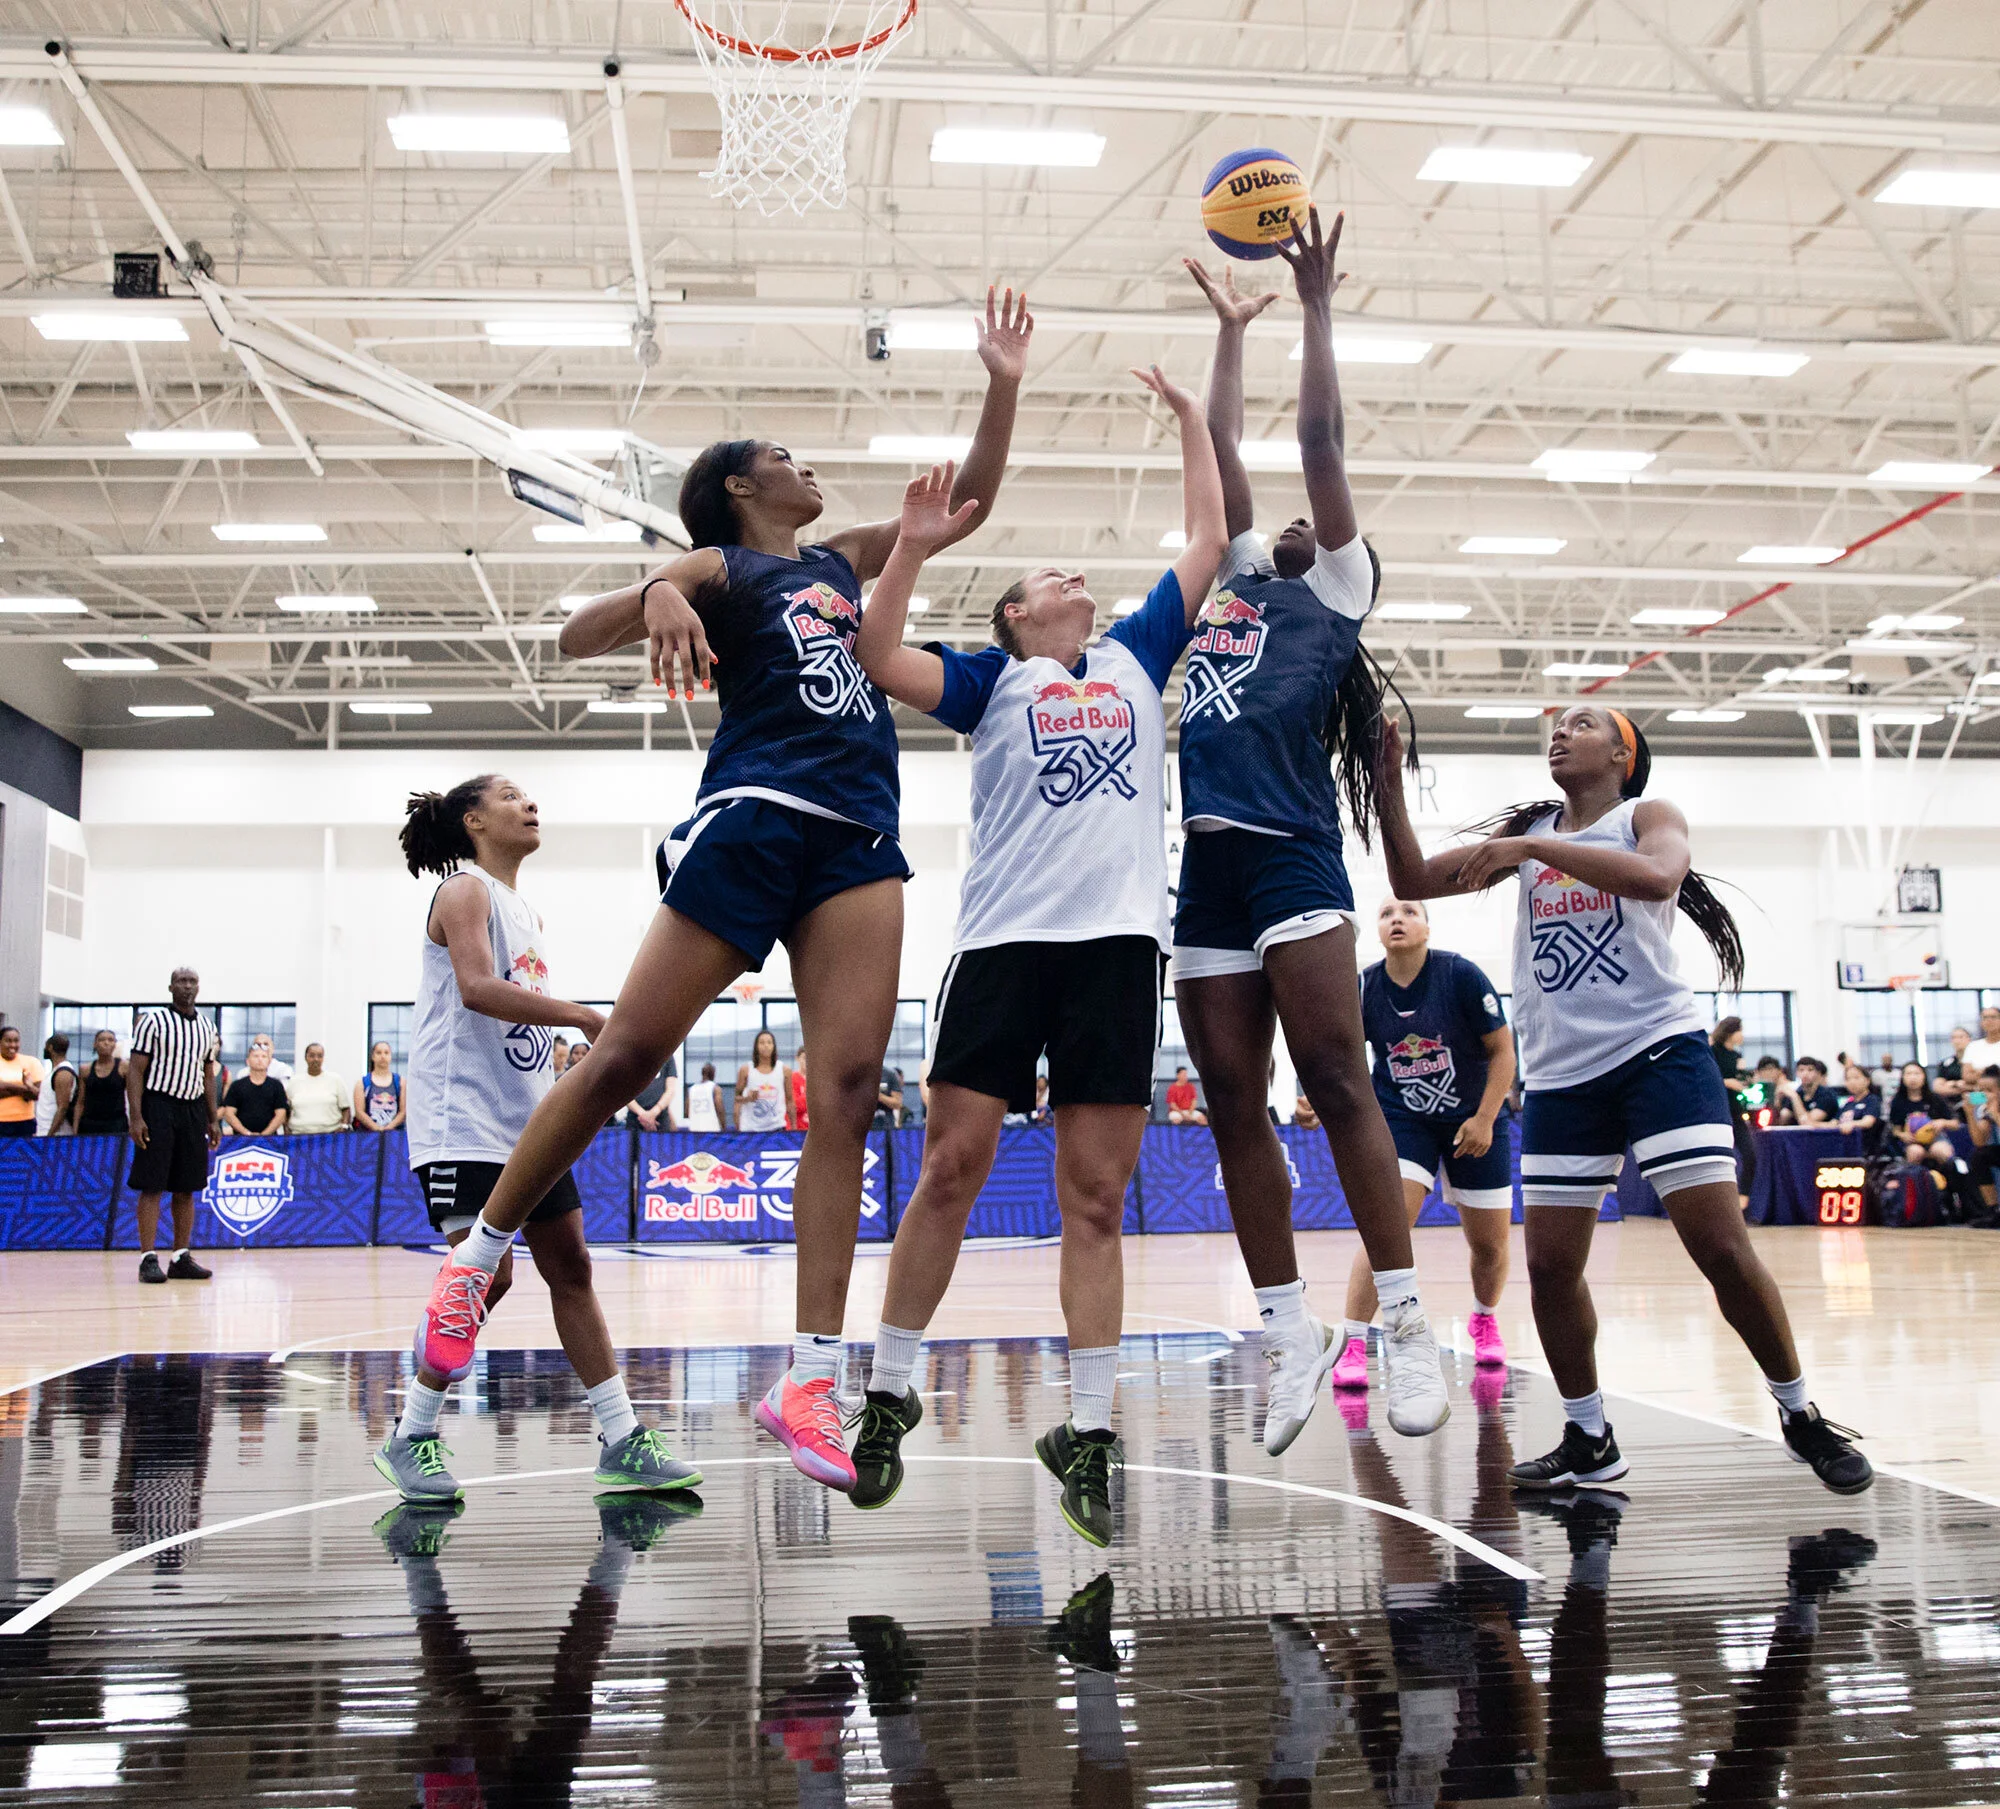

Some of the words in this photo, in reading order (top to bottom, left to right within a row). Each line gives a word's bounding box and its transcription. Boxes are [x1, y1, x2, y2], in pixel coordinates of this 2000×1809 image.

[1228, 169, 1302, 197] Wilson
[1214, 629, 1260, 656] Bull
[1036, 707, 1085, 733] Red
[1087, 707, 1129, 729] Bull
[1034, 734, 1138, 807] 3X
[1533, 892, 1569, 919] Red
[1570, 890, 1611, 913] Bull
[1531, 915, 1629, 993] 3X
[1391, 1060, 1420, 1078] Red
[1420, 1052, 1449, 1074] Bull
[225, 1162, 276, 1182] USA
[646, 1194, 701, 1221] Red
[702, 1194, 757, 1221] Bull
[1820, 1191, 1862, 1223] 09
